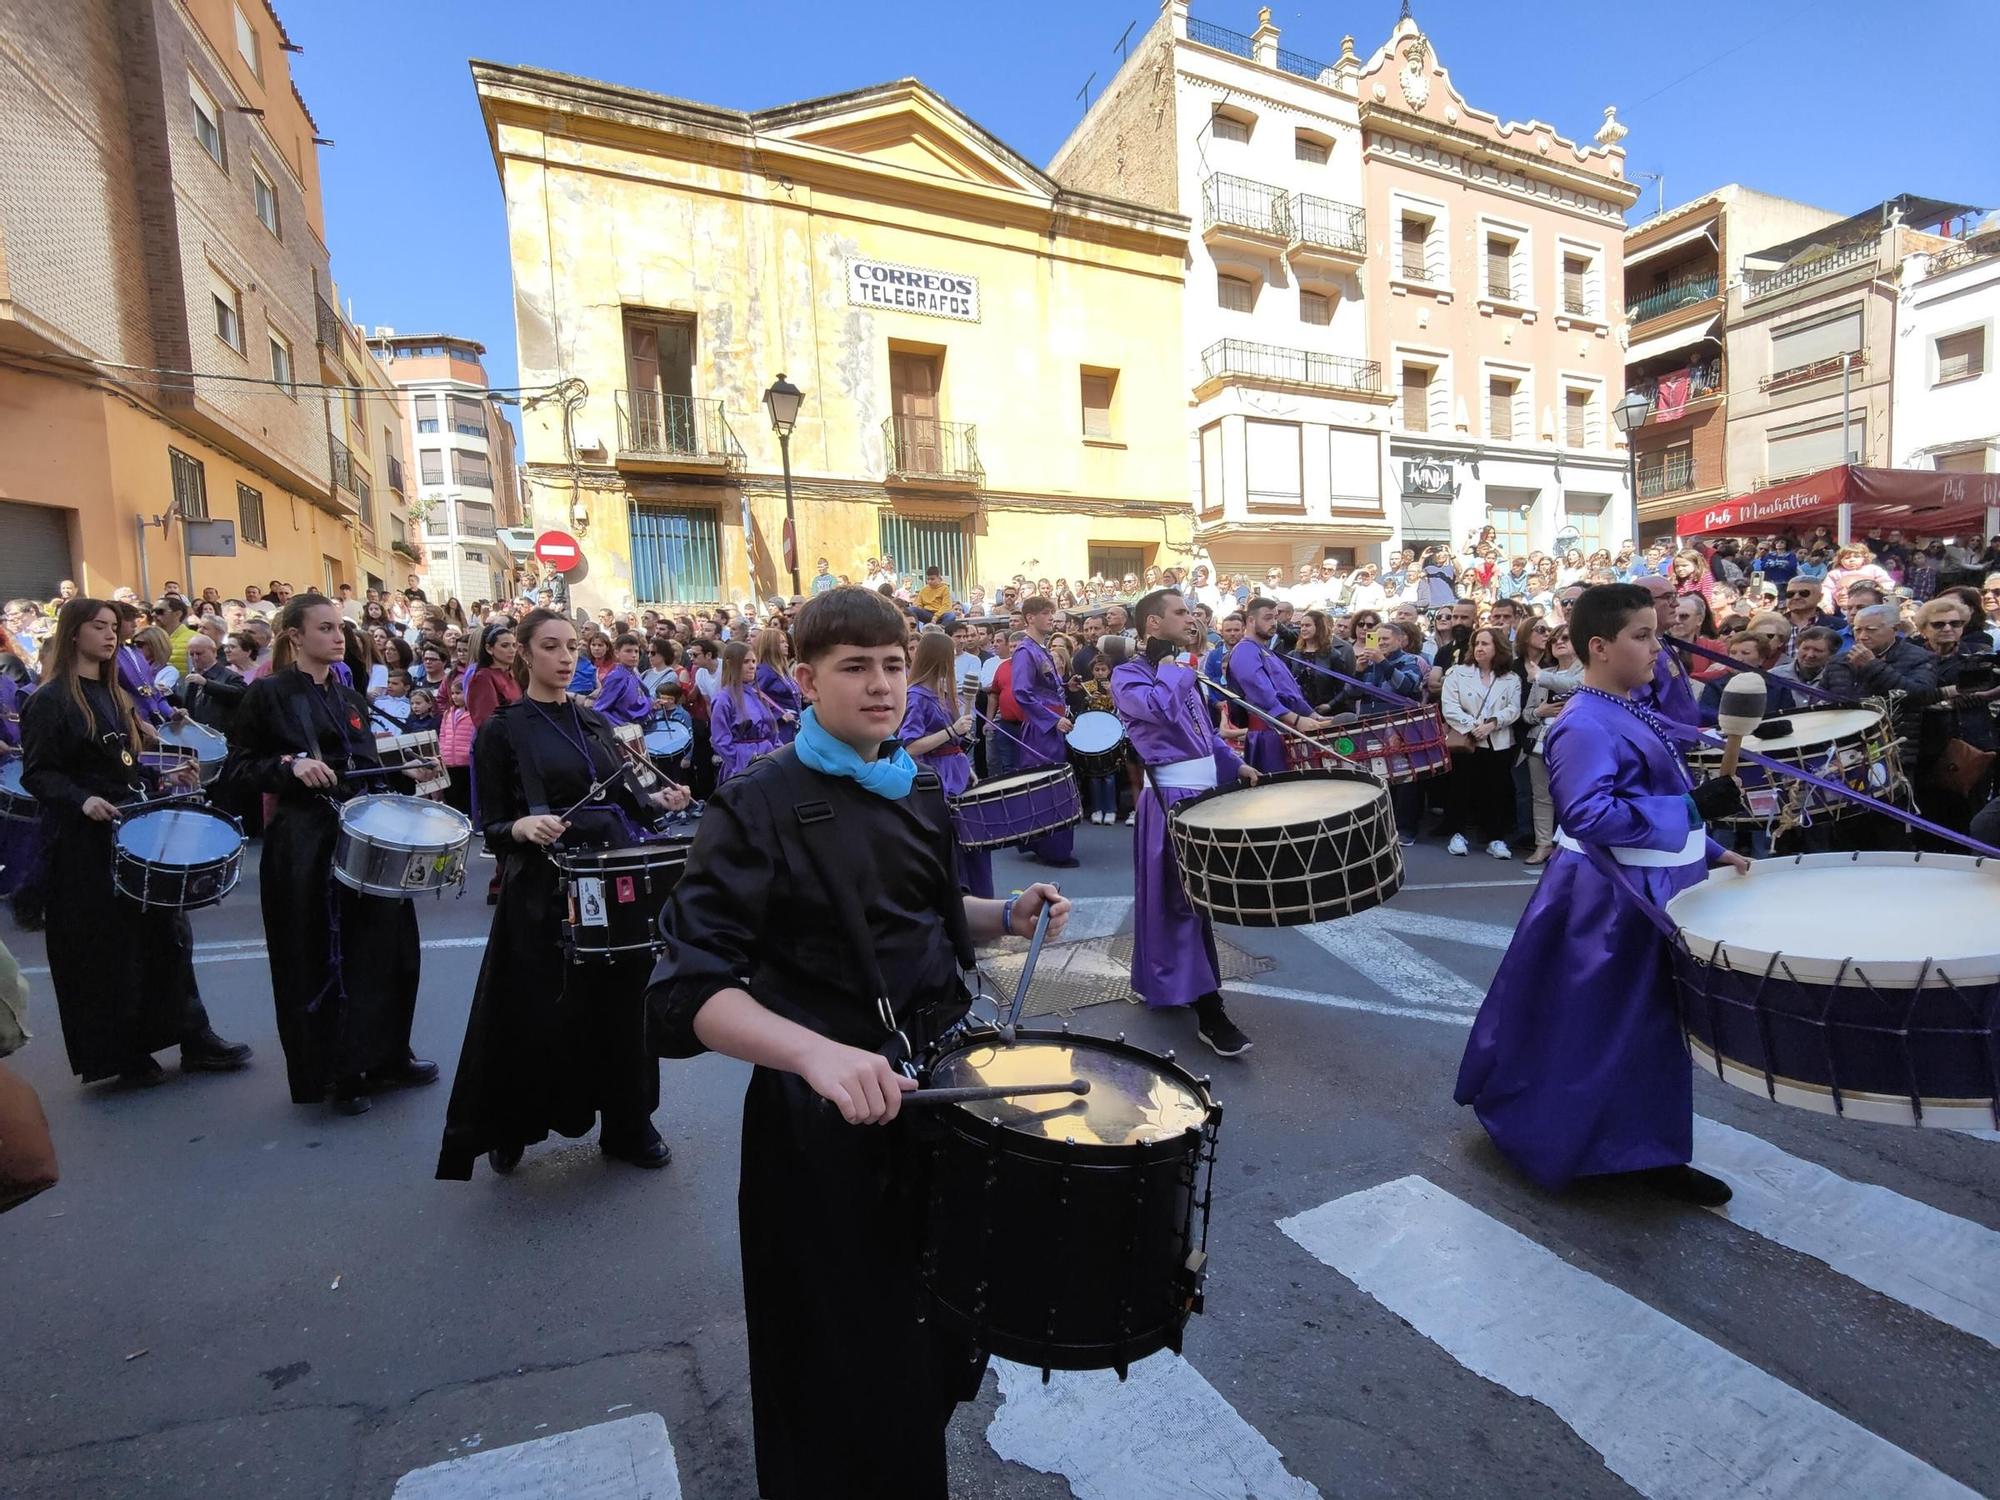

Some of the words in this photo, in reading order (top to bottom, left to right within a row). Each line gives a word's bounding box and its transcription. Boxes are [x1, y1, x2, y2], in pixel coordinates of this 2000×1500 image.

[854, 263, 972, 296] CORREOS
[859, 283, 970, 315] TELEGRAFOS
[1705, 508, 1732, 529] Pub
[1740, 493, 1821, 521] Manhattan
